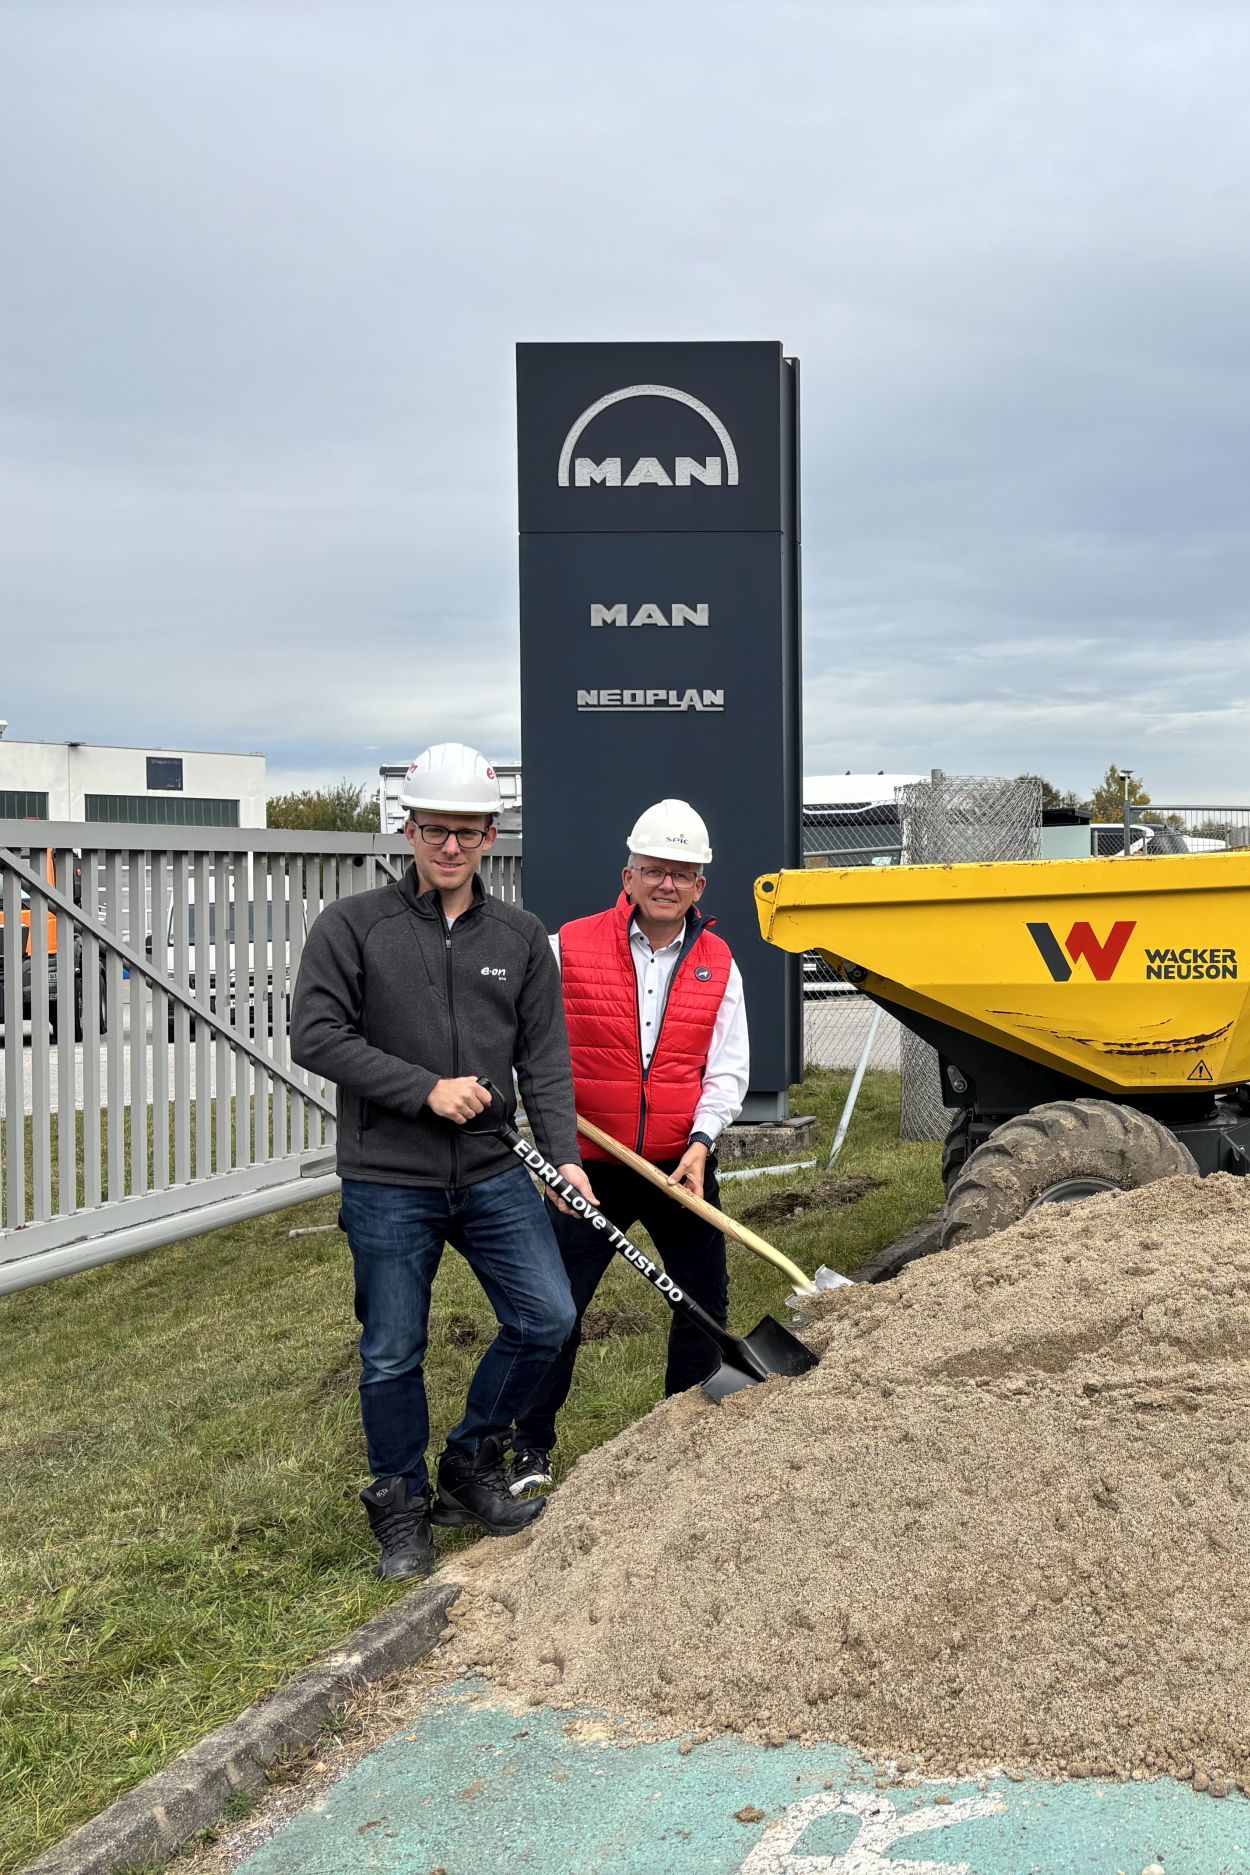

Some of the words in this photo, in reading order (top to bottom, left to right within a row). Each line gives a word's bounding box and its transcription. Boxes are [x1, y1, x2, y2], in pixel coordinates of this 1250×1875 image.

[574, 456, 722, 487] MAN
[590, 603, 710, 627] MAN
[576, 688, 725, 712] NEOPLAN
[1144, 949, 1237, 964] WACKER
[1146, 964, 1237, 980] NEUSON
[513, 1139, 564, 1188] EDRI
[560, 1184, 606, 1230] Love
[607, 1225, 656, 1277] Trust
[654, 1272, 683, 1302] Do
